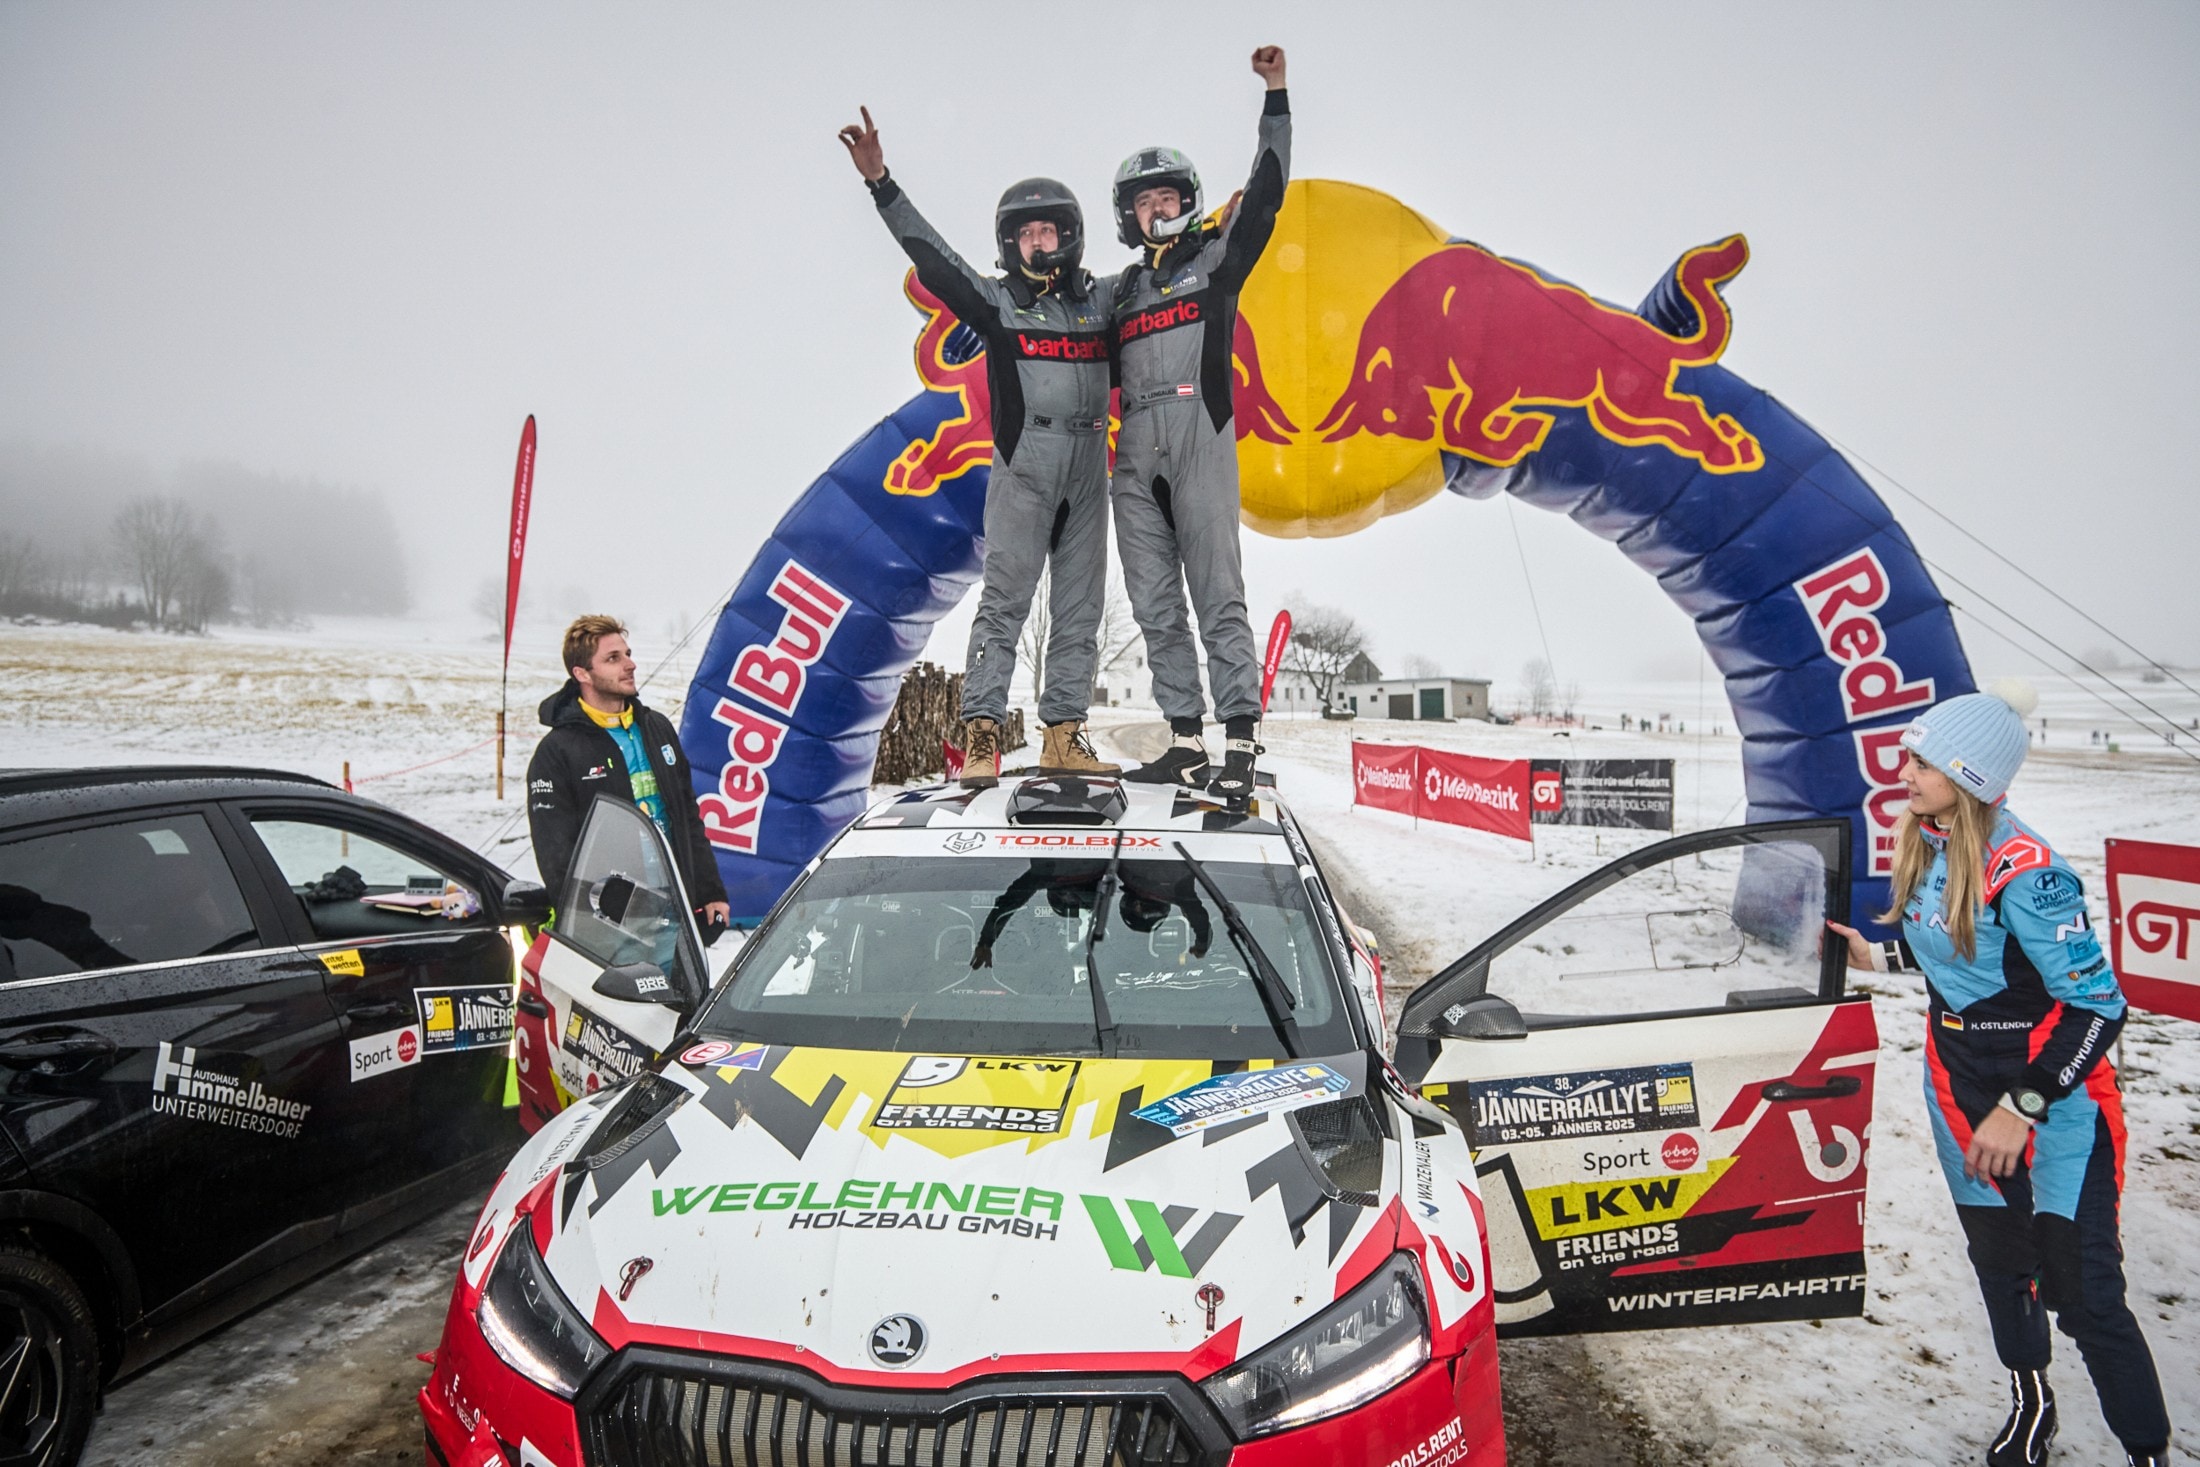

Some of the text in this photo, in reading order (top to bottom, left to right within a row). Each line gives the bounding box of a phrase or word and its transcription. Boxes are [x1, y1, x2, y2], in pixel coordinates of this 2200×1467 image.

[1798, 550, 1934, 720] Red
[698, 561, 850, 852] Red Bull
[1533, 779, 1560, 804] GT
[995, 835, 1162, 847] TOOLBOX
[331, 959, 361, 970] wetten
[2069, 1016, 2106, 1070] HYUNDAI
[355, 1044, 393, 1073] Sport
[976, 1061, 1069, 1073] LKW
[193, 1069, 239, 1087] AUTOHAUS
[561, 1062, 584, 1092] Sport
[1164, 1067, 1312, 1116] JÄNNERRALLYE
[1555, 1077, 1573, 1091] 38.
[1669, 1078, 1689, 1087] LKW
[152, 1094, 303, 1140] UNTERWEITERSDORF
[879, 1104, 1060, 1124] FRIENDS
[1478, 1081, 1653, 1128] JÄNNERRALLYE
[1658, 1102, 1696, 1113] FRIENDS
[875, 1117, 1057, 1133] on the road
[1501, 1118, 1636, 1141] 03.-05. JÄNNER 2025
[1583, 1147, 1651, 1176] Sport
[1661, 1144, 1700, 1159] ober
[1414, 1140, 1433, 1201] WAIZENAUER
[652, 1178, 1065, 1222] WEGLEHNER
[1551, 1178, 1682, 1227] LKW
[788, 1210, 1059, 1242] HOLZBAU GMBH
[1556, 1222, 1679, 1259] FRIENDS
[1559, 1240, 1680, 1271] on the road
